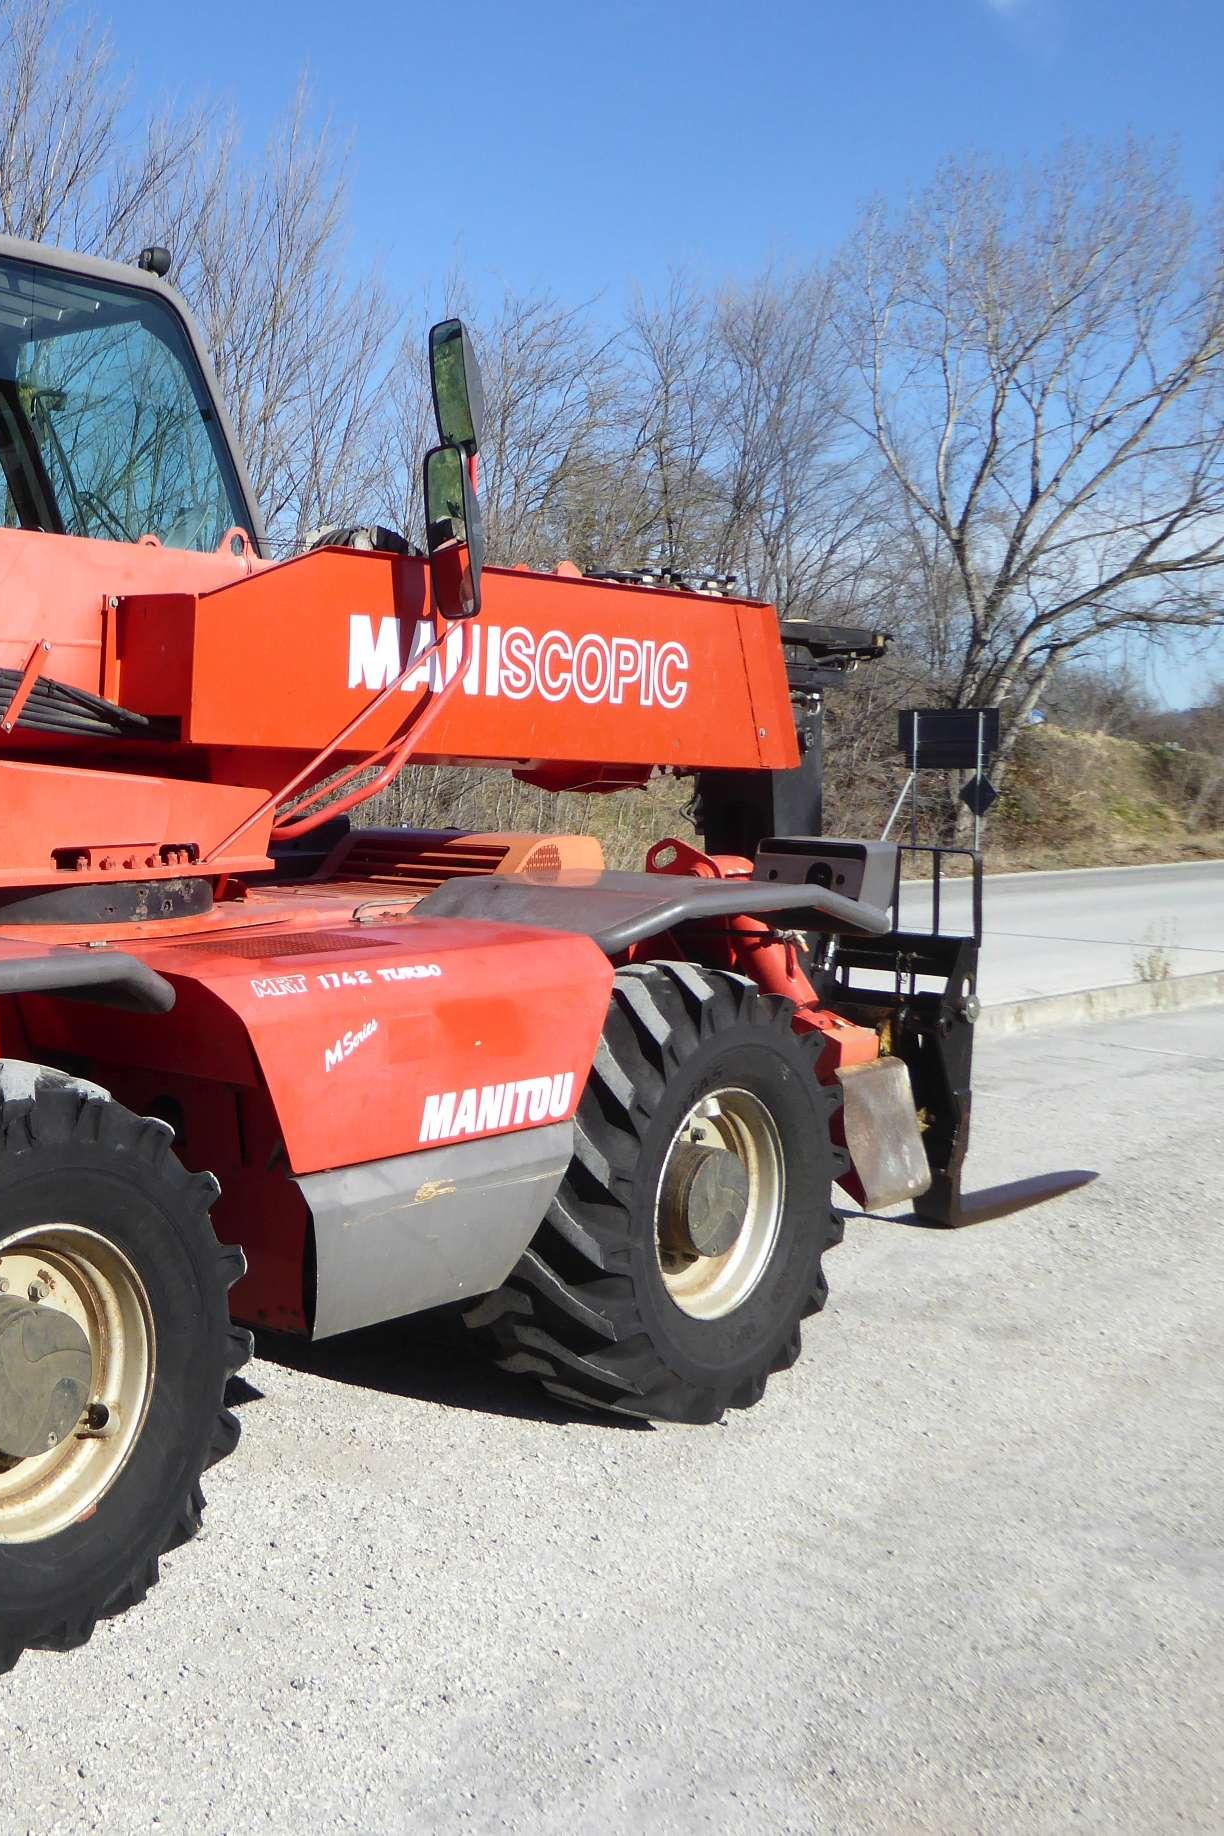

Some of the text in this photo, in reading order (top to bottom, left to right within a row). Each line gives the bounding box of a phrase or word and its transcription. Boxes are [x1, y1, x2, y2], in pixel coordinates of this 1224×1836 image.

[348, 613, 689, 709] MANISCOPIC
[251, 963, 443, 998] MRT 1742 TURBO
[418, 1072, 574, 1143] MANITOU
